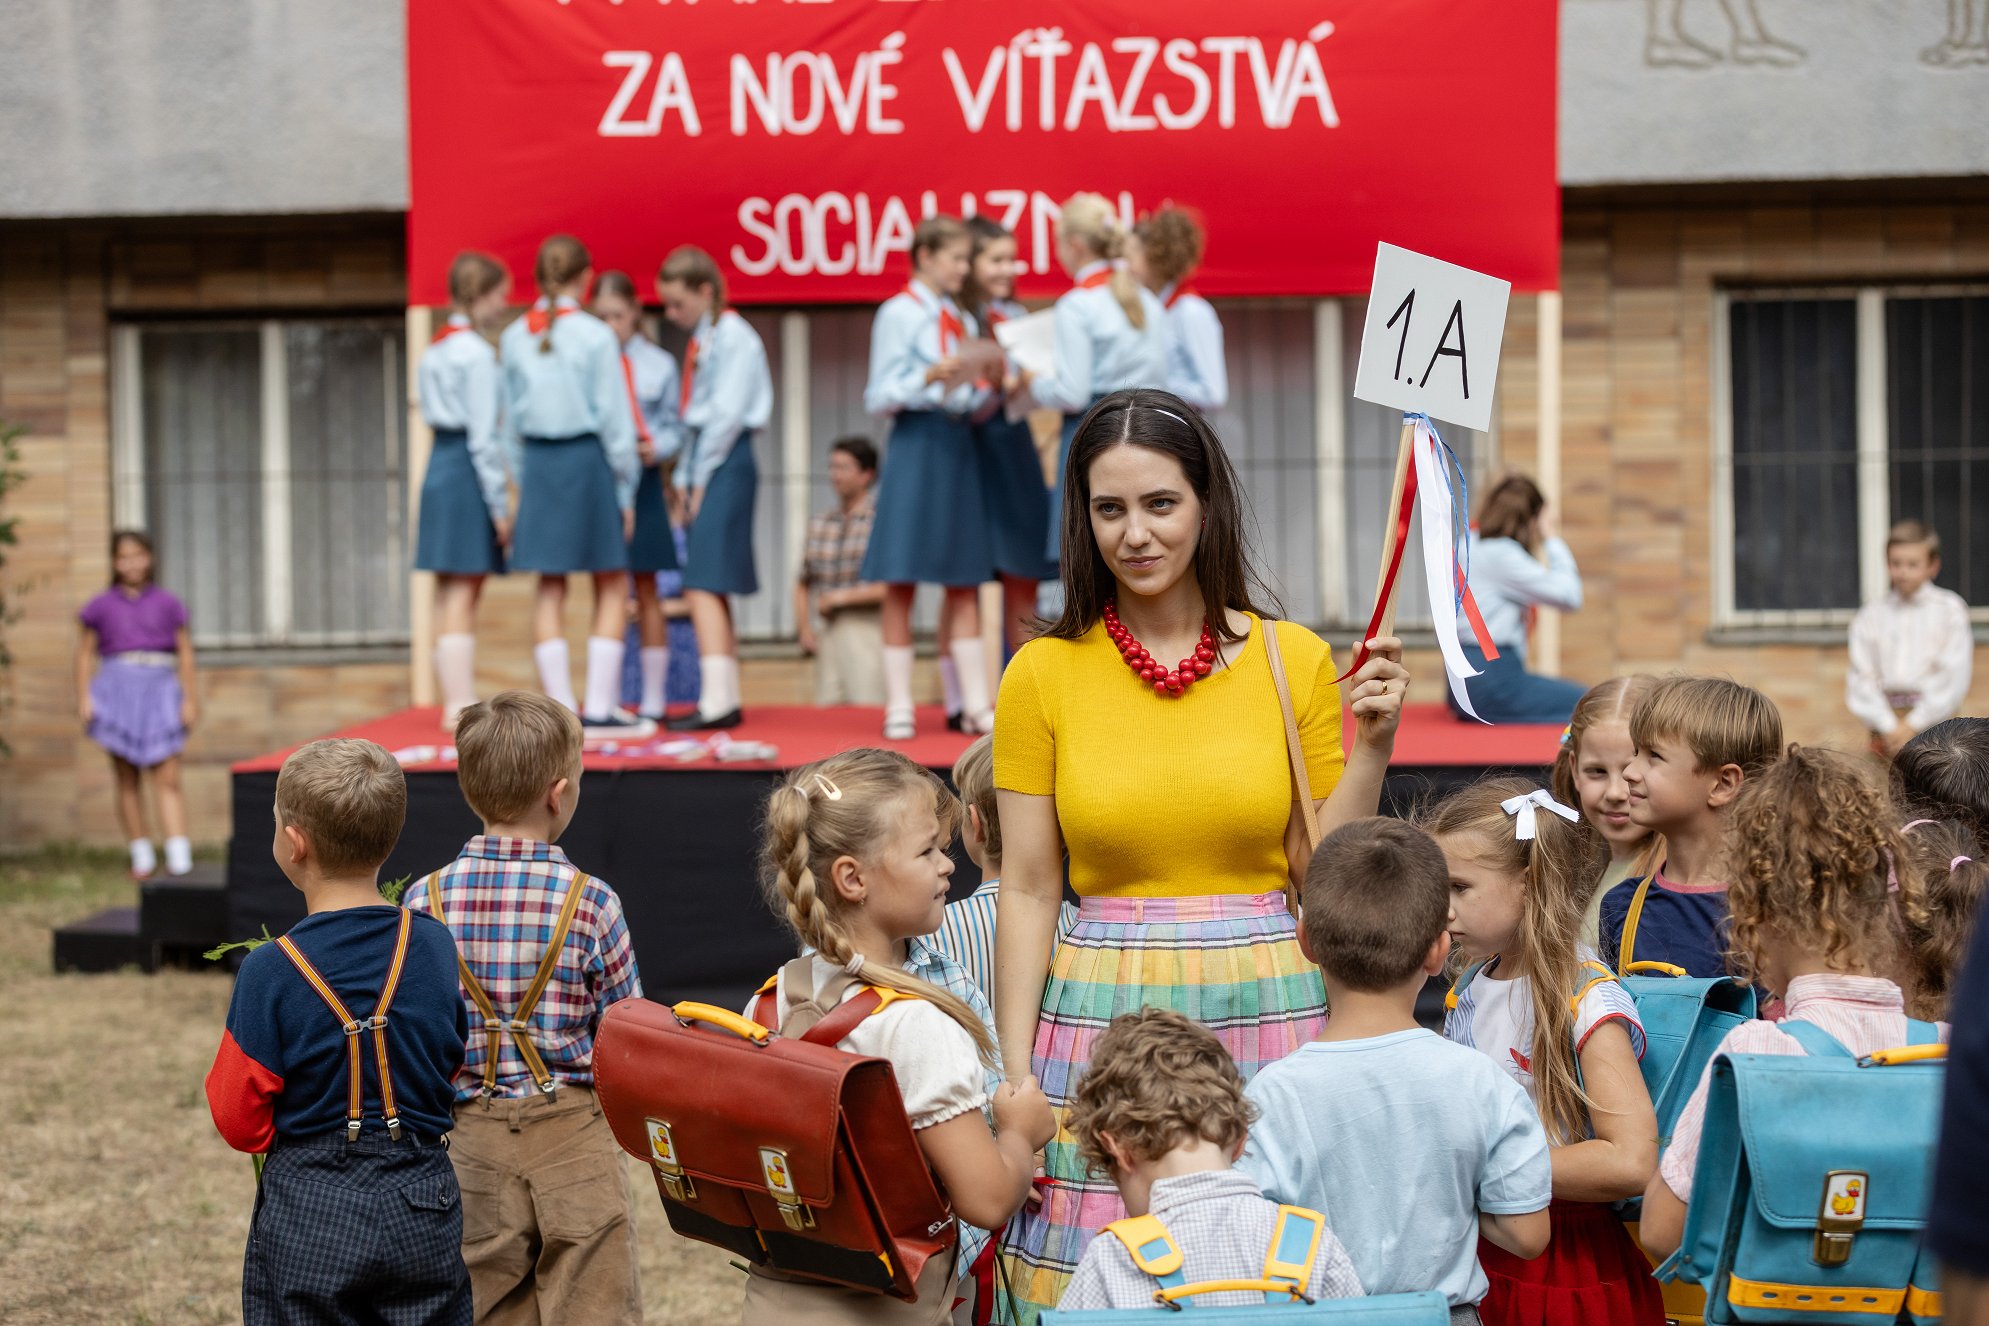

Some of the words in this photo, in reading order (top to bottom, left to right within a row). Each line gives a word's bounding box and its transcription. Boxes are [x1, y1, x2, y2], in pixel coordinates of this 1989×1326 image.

[598, 50, 701, 137] ZA
[730, 31, 906, 136] NOVÉ
[942, 21, 1340, 132] VÍŤAZSTVÁ
[731, 190, 1172, 276] SOCIAZ
[1386, 288, 1470, 400] 1.A
